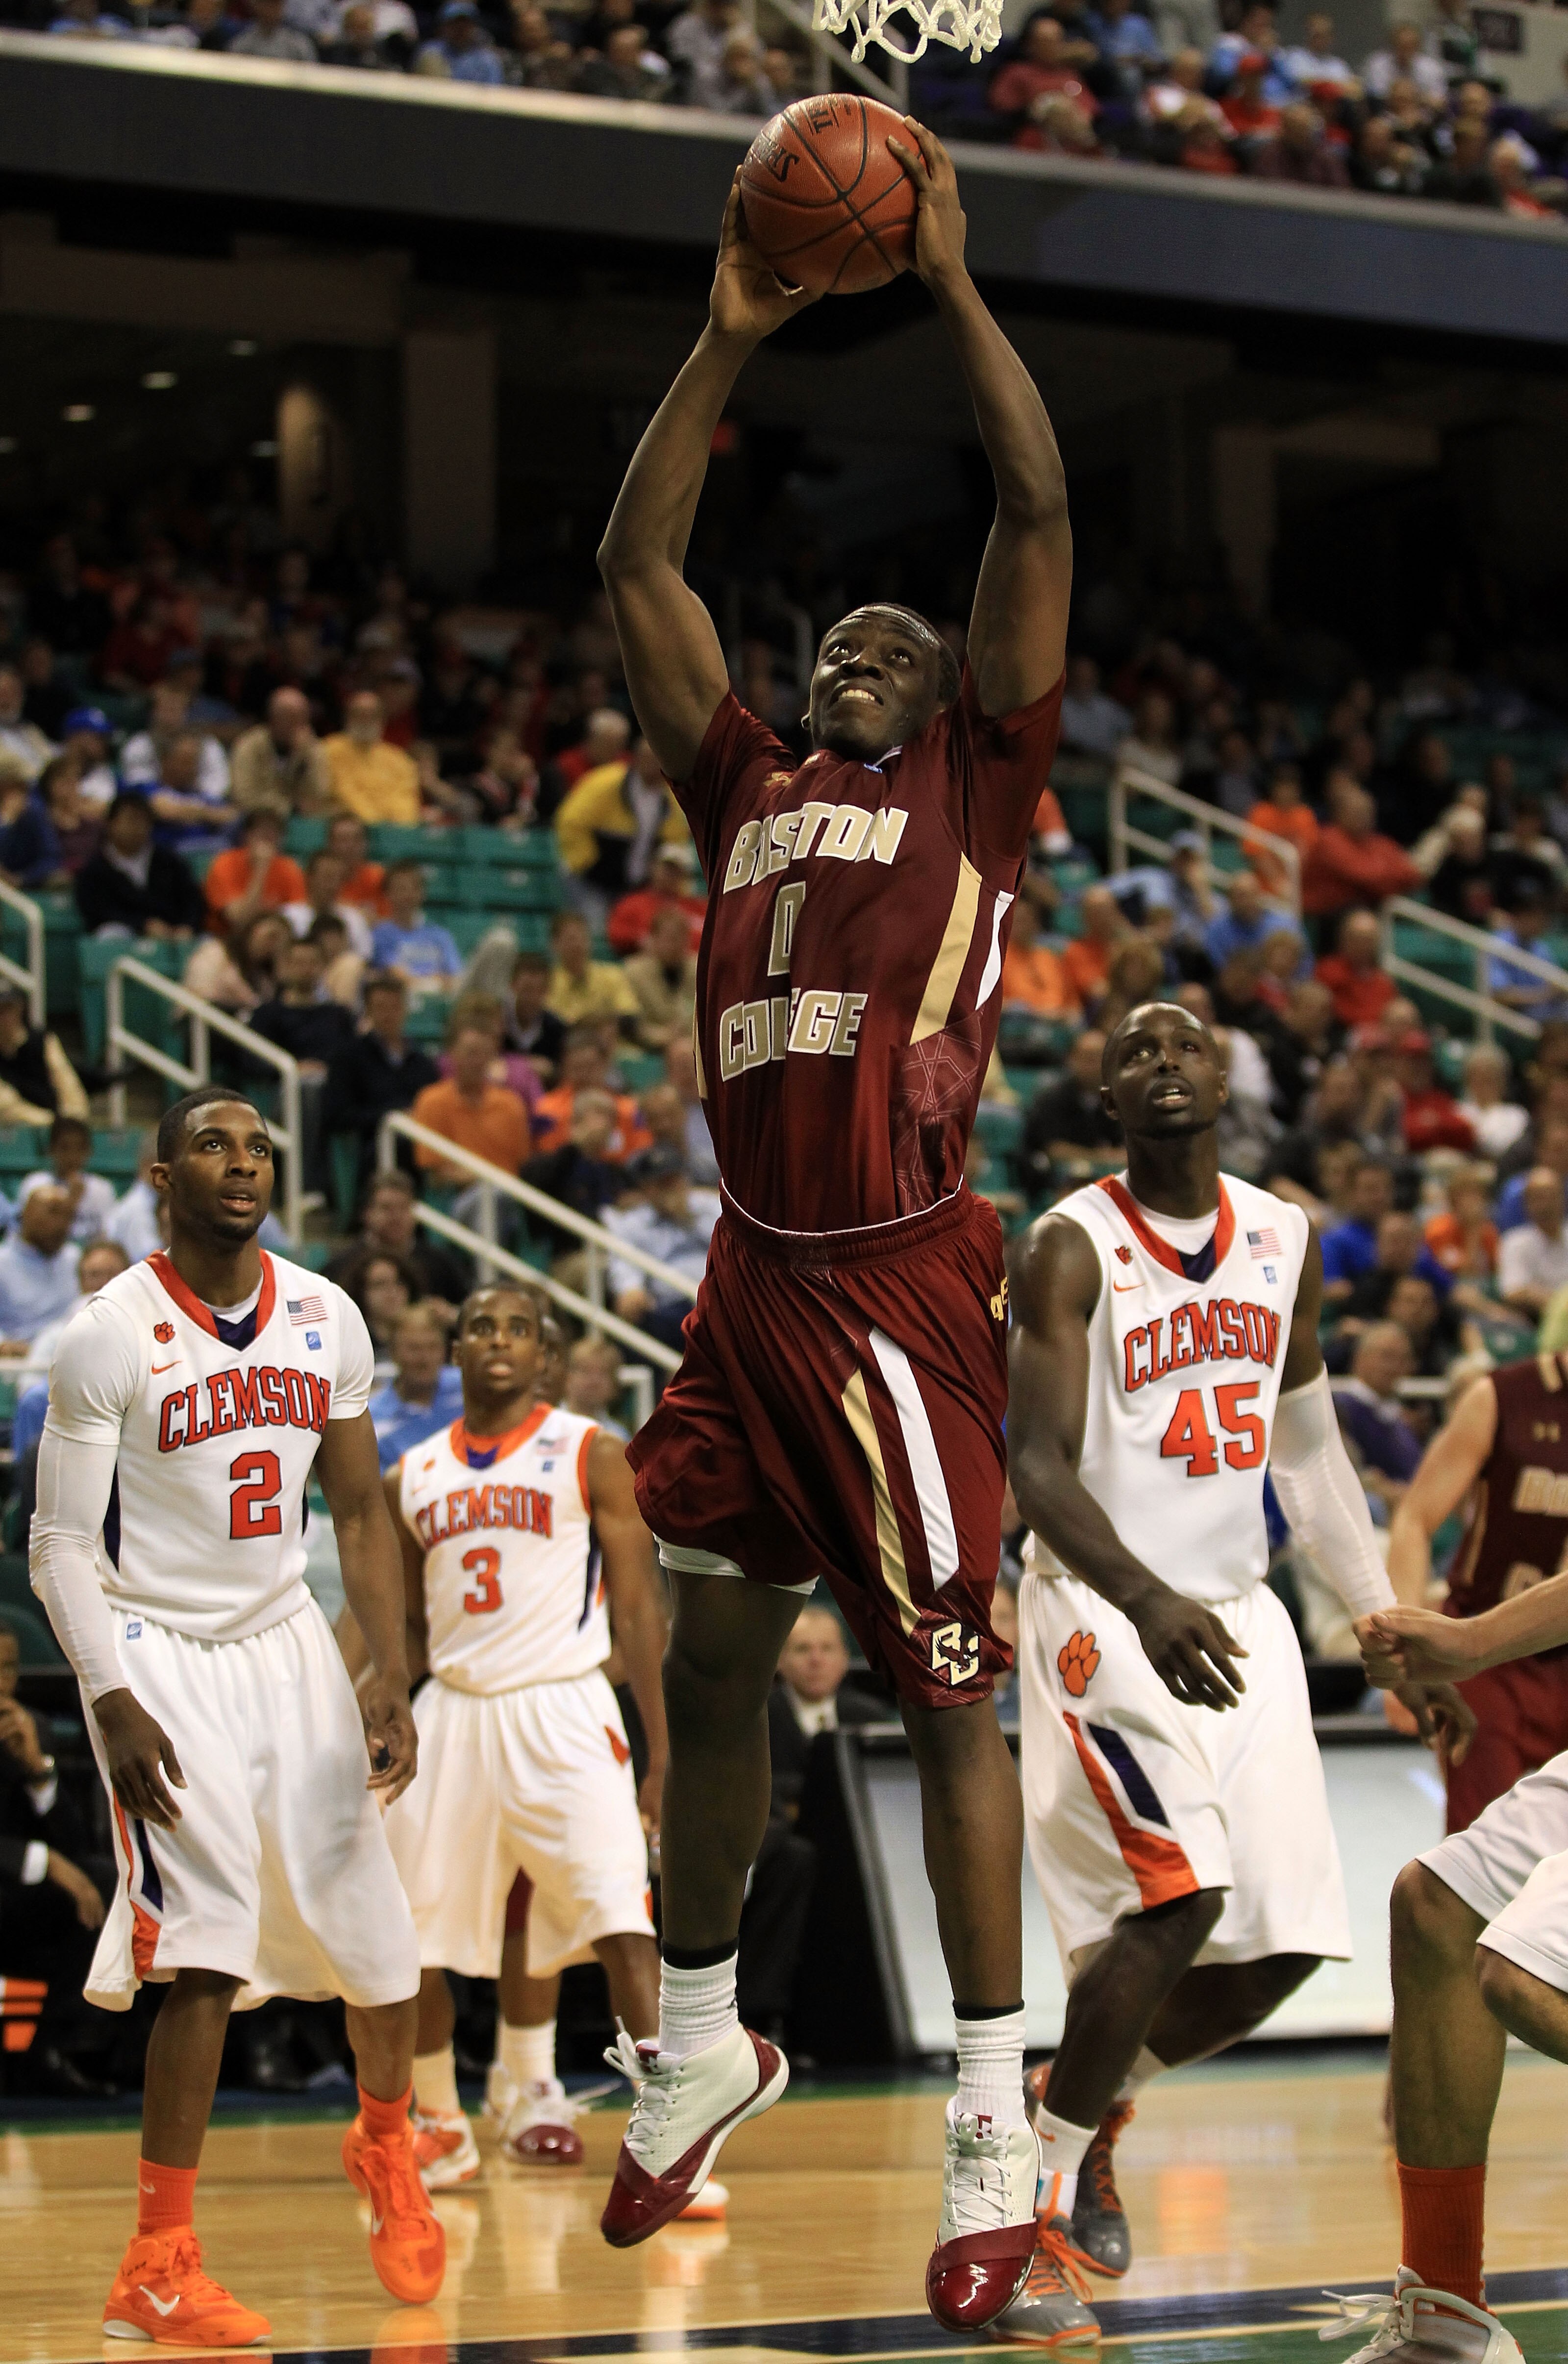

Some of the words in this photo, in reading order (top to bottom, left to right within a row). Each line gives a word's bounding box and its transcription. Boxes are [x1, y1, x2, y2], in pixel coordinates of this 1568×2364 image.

[767, 881, 806, 976] 0
[1123, 1298, 1282, 1393] CLEMSON
[158, 1366, 331, 1453] CLEMSON
[1160, 1380, 1266, 1477] 45
[229, 1449, 282, 1540] 2
[415, 1485, 553, 1552] CLEMSON
[462, 1546, 503, 1615] 3
